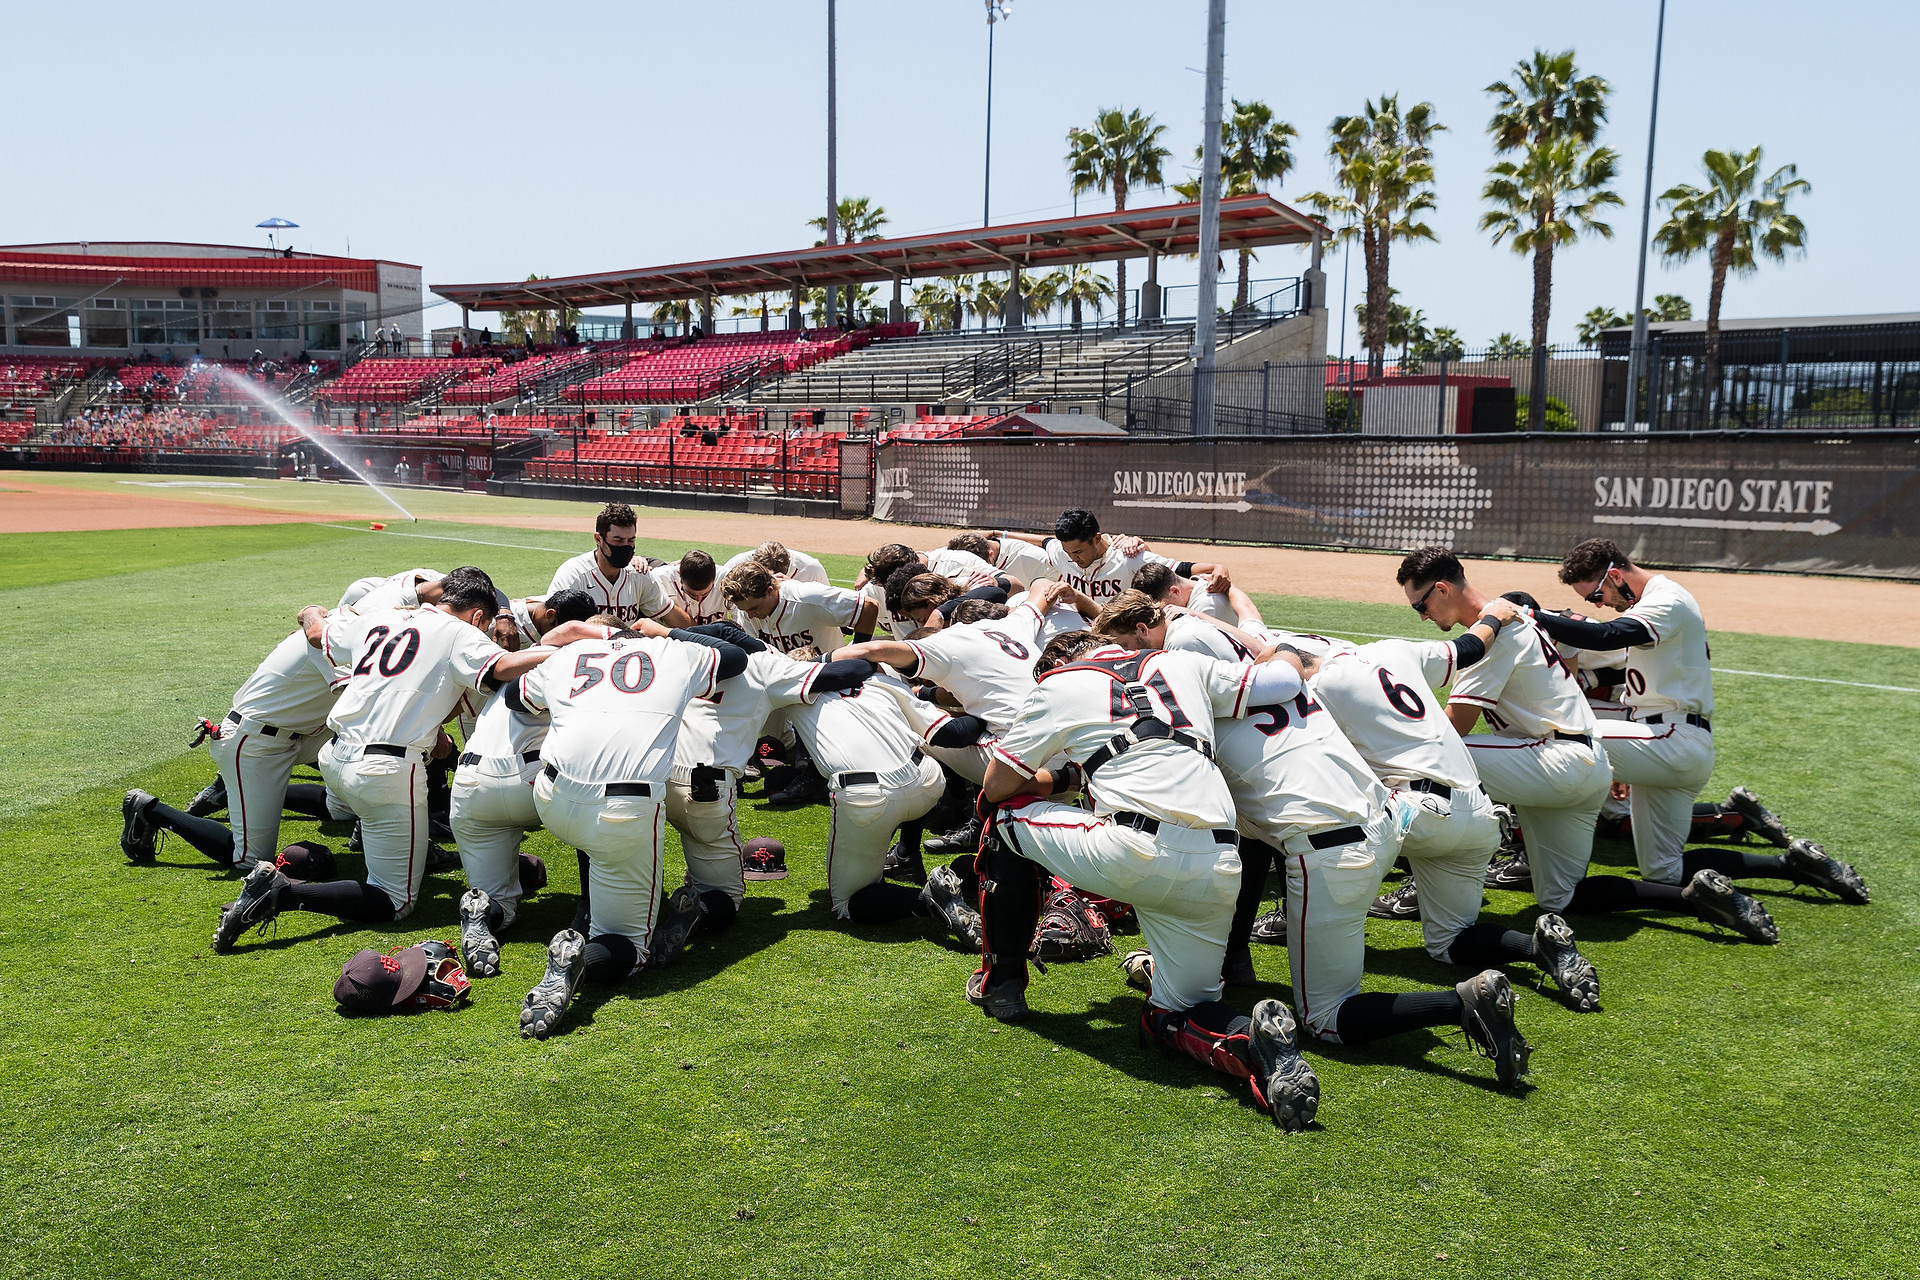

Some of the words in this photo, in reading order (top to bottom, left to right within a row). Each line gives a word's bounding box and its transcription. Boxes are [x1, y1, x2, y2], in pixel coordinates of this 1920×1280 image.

[469, 455, 488, 471] STATE
[1113, 470, 1142, 495] SAN
[1146, 471, 1194, 496] DIEGO
[1196, 471, 1247, 497] STATE
[1593, 476, 1644, 508] SAN
[1649, 477, 1734, 512] DIEGO
[1738, 478, 1833, 514] STATE
[353, 625, 420, 678] 20
[983, 631, 1029, 660] 8
[569, 651, 656, 699] 50
[1378, 667, 1426, 720] 6
[1109, 668, 1193, 728] 41
